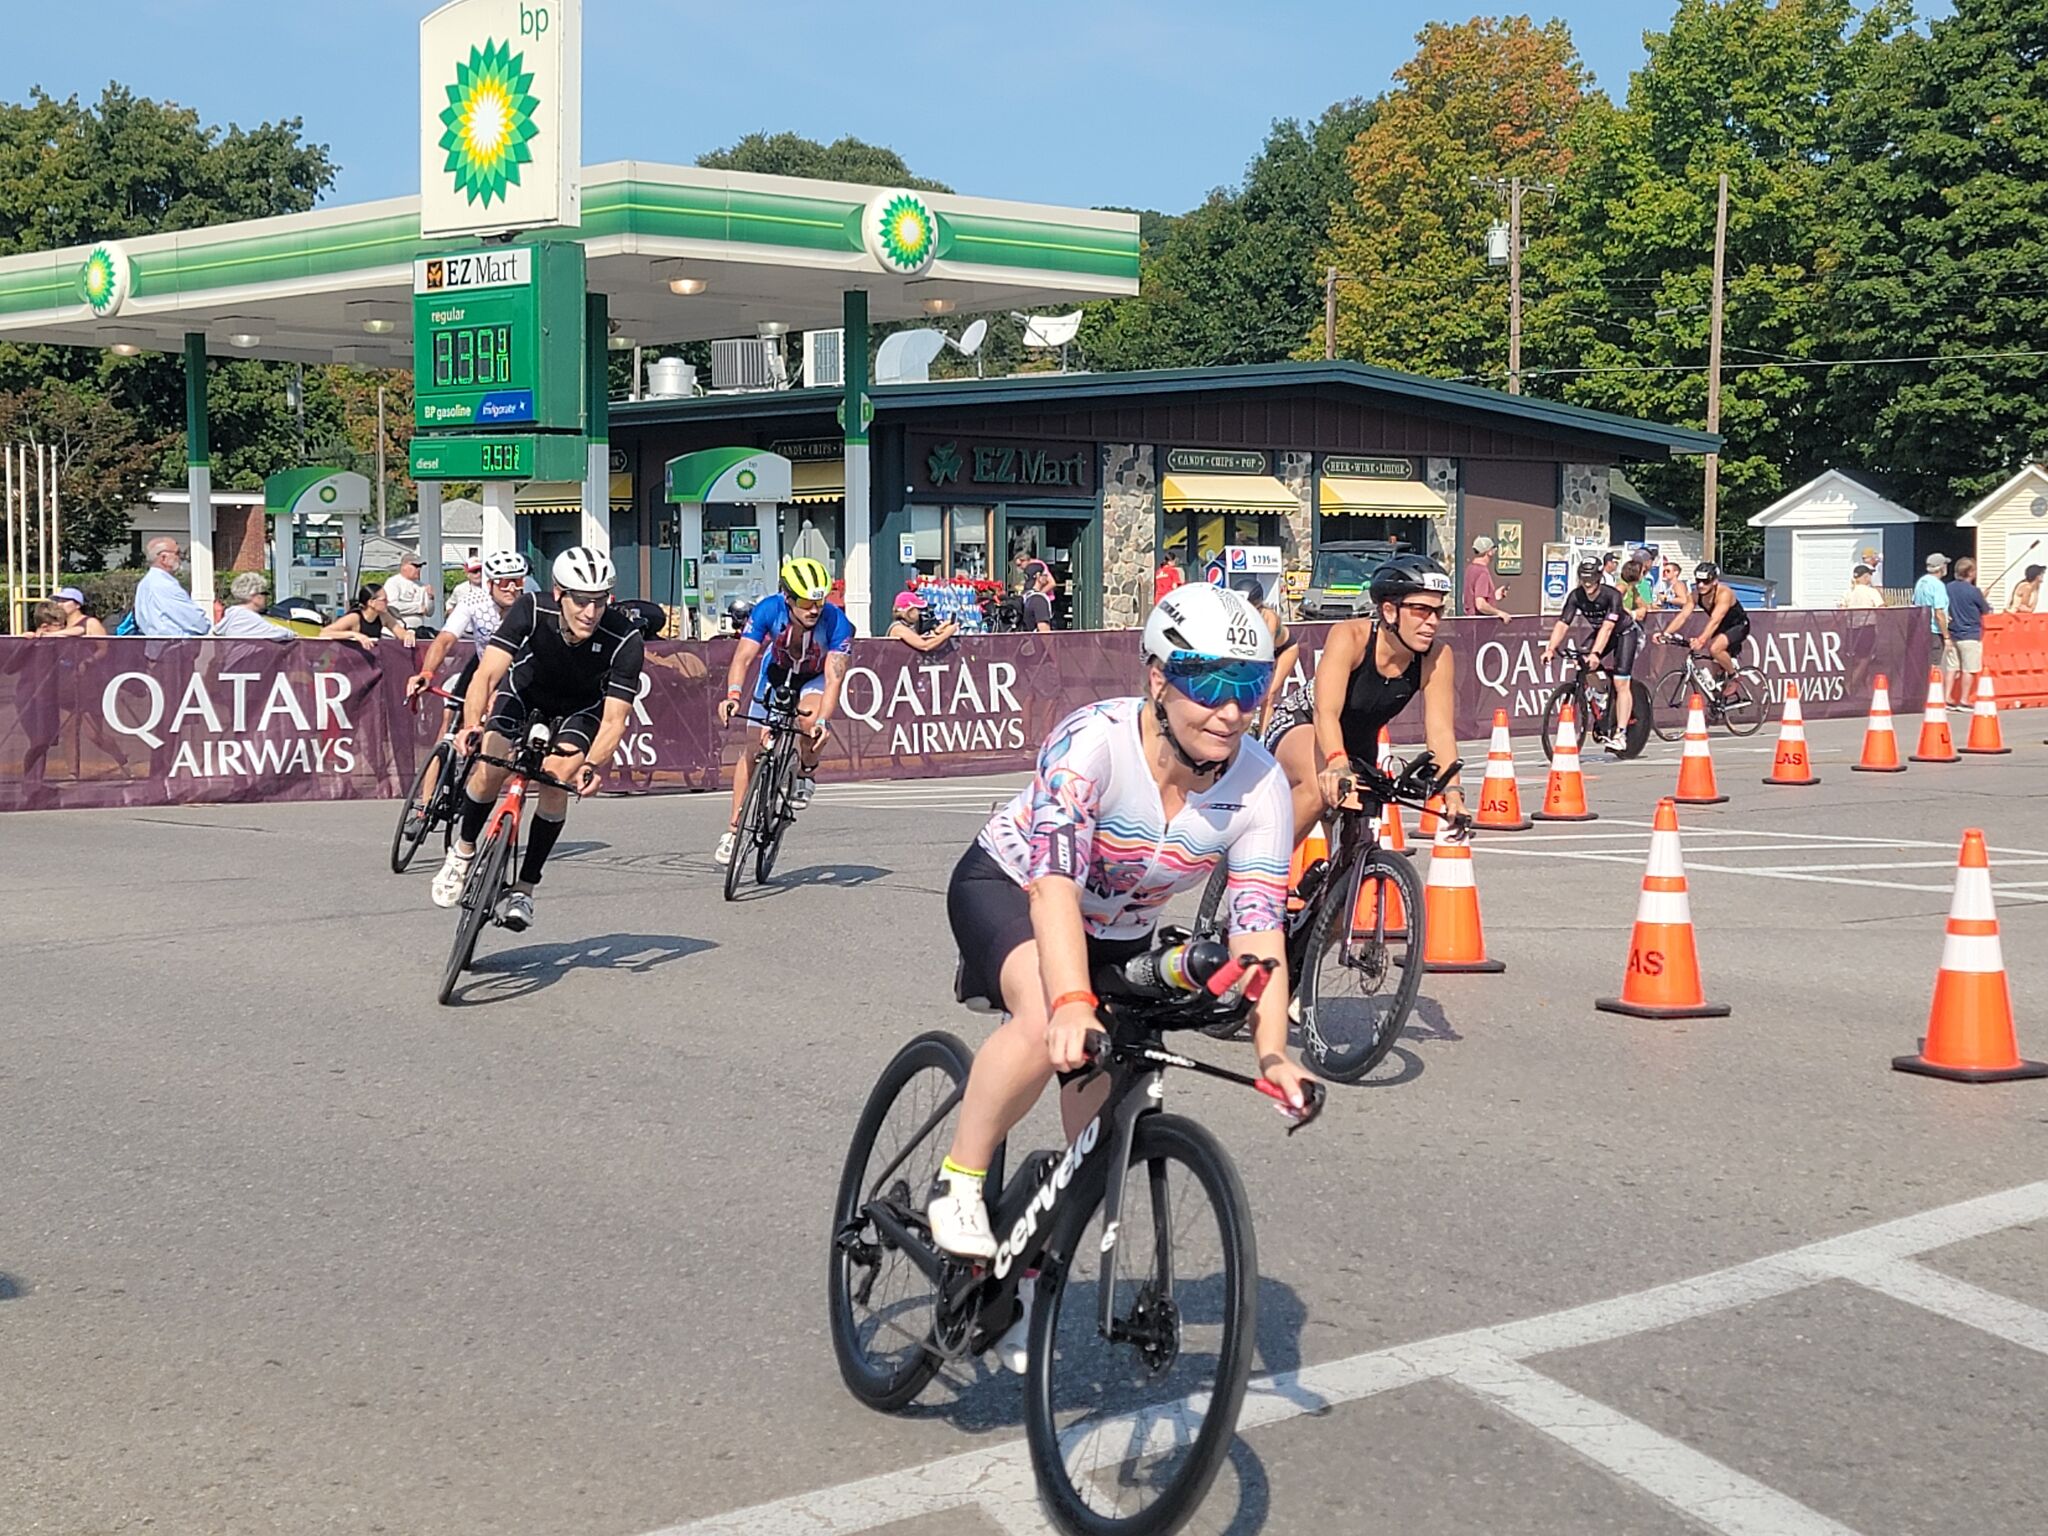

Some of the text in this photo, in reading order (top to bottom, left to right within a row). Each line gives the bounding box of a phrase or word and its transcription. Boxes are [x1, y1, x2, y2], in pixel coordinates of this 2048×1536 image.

[520, 2, 549, 41] bp
[446, 254, 518, 287] EZ Mart
[431, 307, 465, 324] regular
[424, 405, 436, 419] BP
[436, 404, 472, 420] gasoline
[416, 458, 439, 470] diesel
[972, 447, 1087, 487] EZ Mart
[1177, 455, 1257, 468] CANDY CHIPS POP
[1330, 461, 1405, 474] BEER WINE LIQUOR
[1226, 627, 1258, 647] 420
[102, 671, 354, 749] QATAR
[839, 662, 1023, 732] QATAR
[889, 718, 1025, 755] AIRWAYS
[168, 737, 355, 778] AIRWAYS
[1481, 800, 1508, 813] LAS
